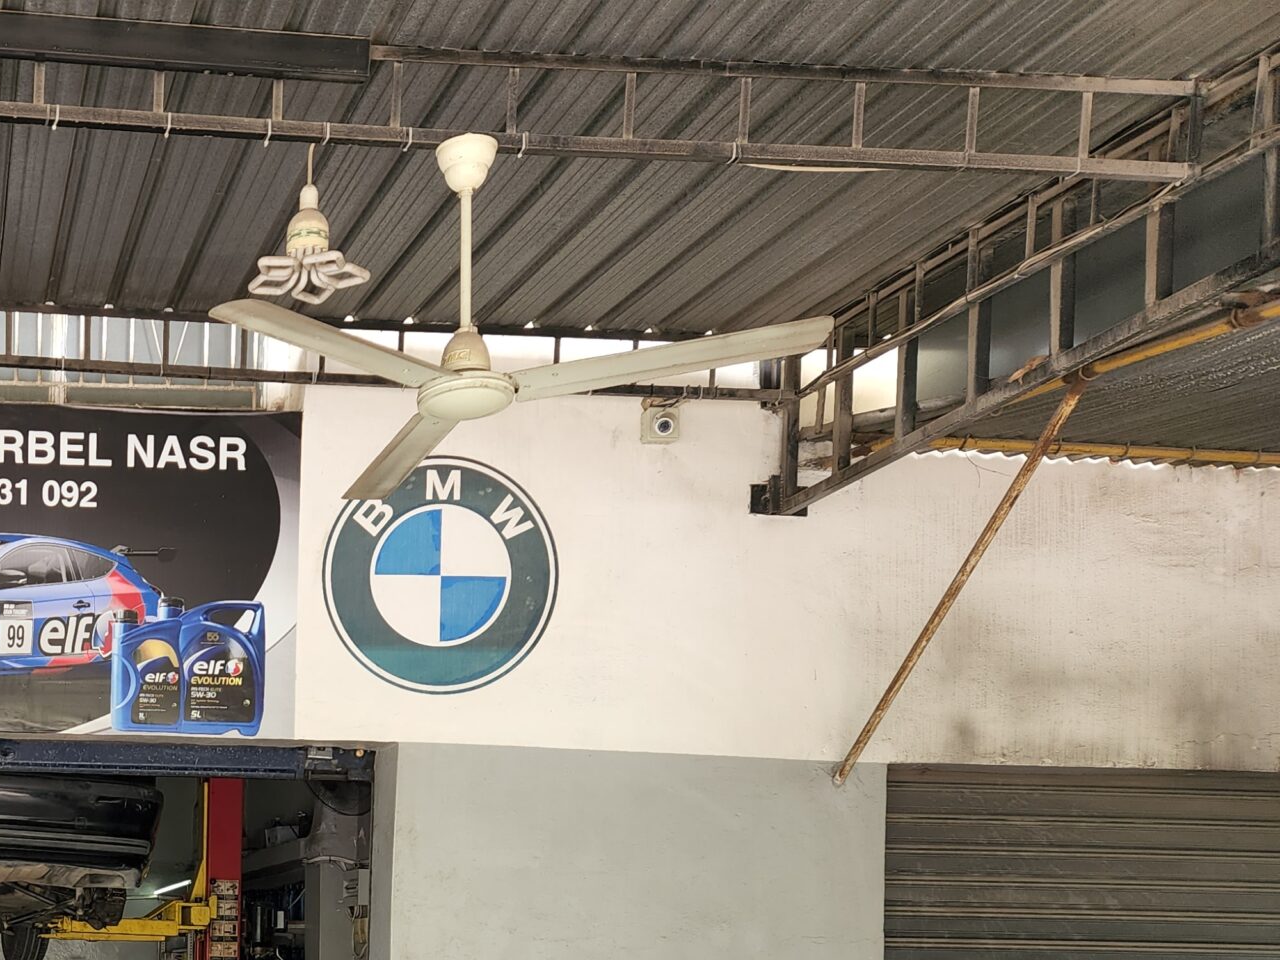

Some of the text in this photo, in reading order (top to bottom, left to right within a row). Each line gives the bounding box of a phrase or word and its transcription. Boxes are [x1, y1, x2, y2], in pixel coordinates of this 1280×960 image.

[126, 433, 248, 471] NASR
[42, 479, 98, 508] 092
[7, 624, 25, 648] 99
[39, 616, 94, 654] elf
[145, 672, 167, 683] elf
[193, 660, 225, 675] elf
[191, 677, 242, 686] EVOLUTION
